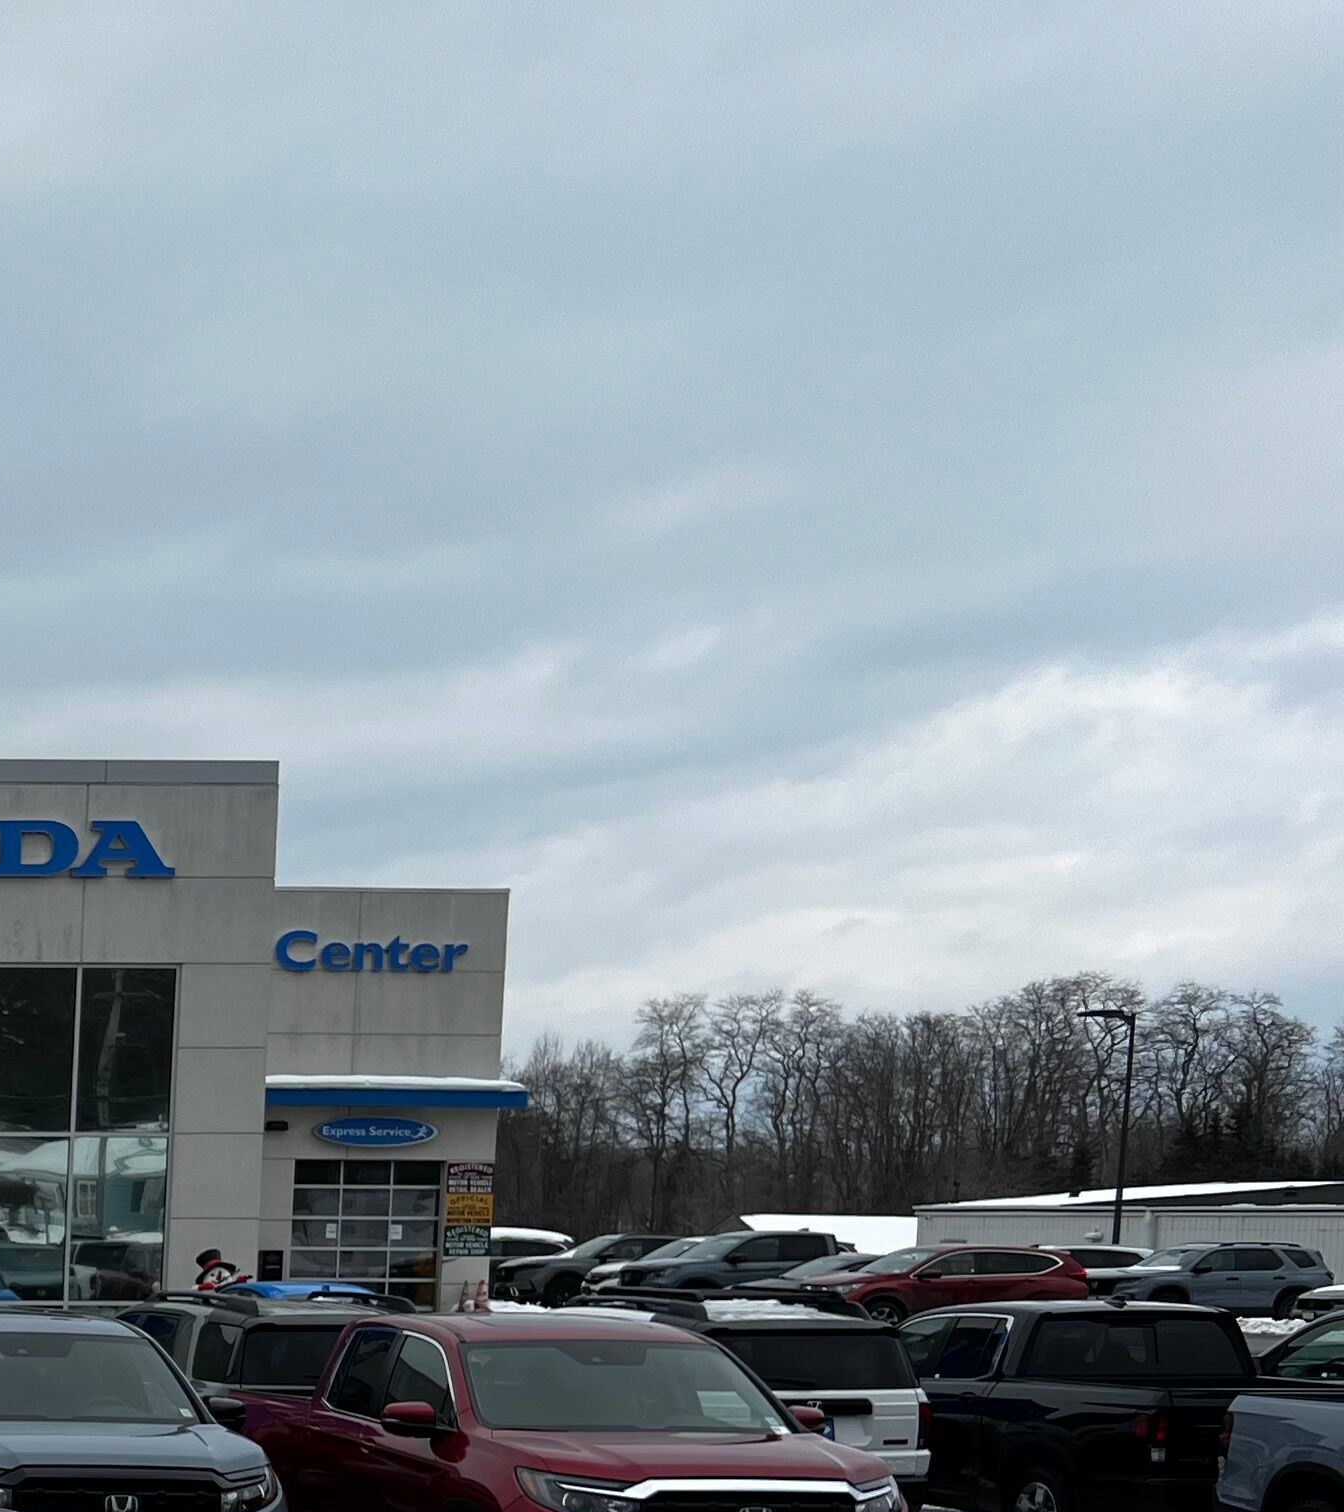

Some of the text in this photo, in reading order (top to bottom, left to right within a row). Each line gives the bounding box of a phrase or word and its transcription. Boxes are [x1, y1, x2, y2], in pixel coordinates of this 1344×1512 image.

[275, 929, 469, 972] Center
[322, 1125, 412, 1138] Express Service
